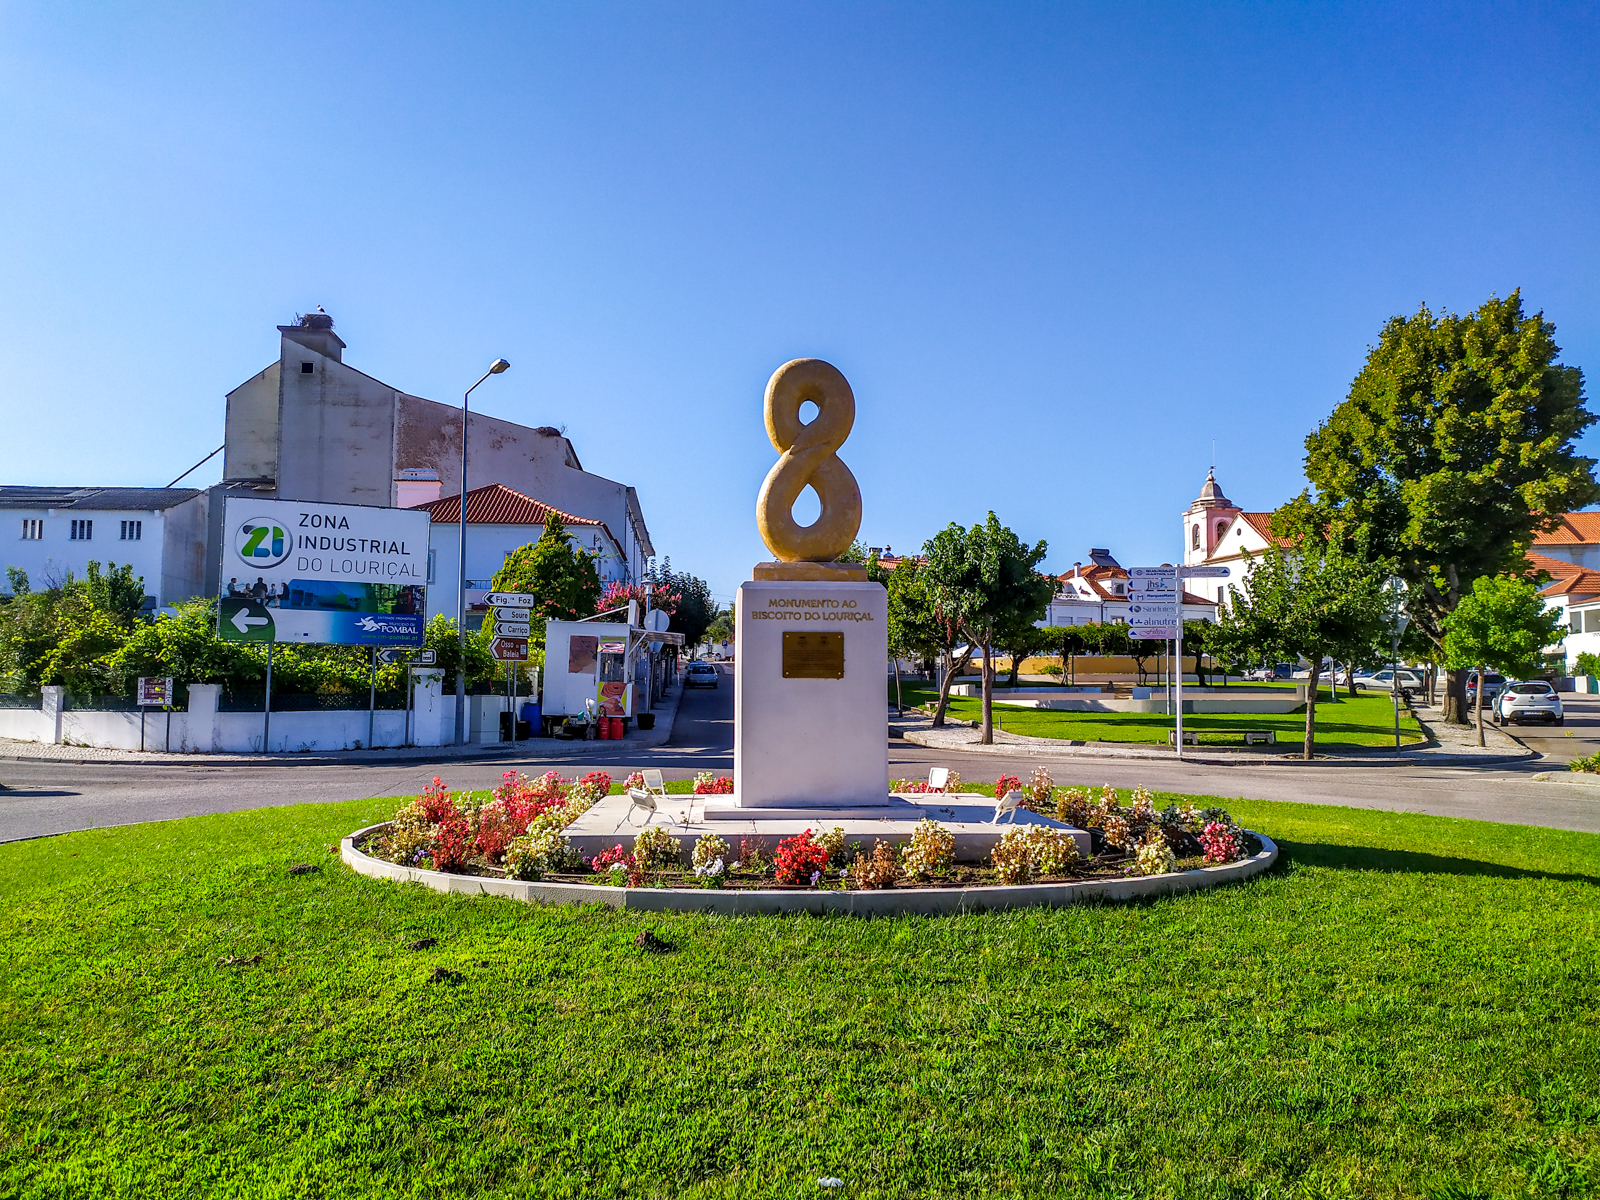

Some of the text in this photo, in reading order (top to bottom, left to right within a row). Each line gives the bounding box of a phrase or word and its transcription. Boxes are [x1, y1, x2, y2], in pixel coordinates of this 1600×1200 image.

[298, 513, 350, 530] ZONA
[298, 534, 411, 556] INDUSTRIAL
[297, 556, 421, 580] DO LOURIÇAL
[1147, 580, 1160, 591] jhs
[518, 596, 531, 604] Foz
[768, 599, 857, 608] MONUMENTO AO
[511, 611, 528, 619] Soure
[751, 611, 874, 622] BISCOITO DO LOURIÇAL
[381, 625, 419, 634] POMBAL
[507, 626, 528, 635] Carriço
[501, 640, 514, 648] Osso
